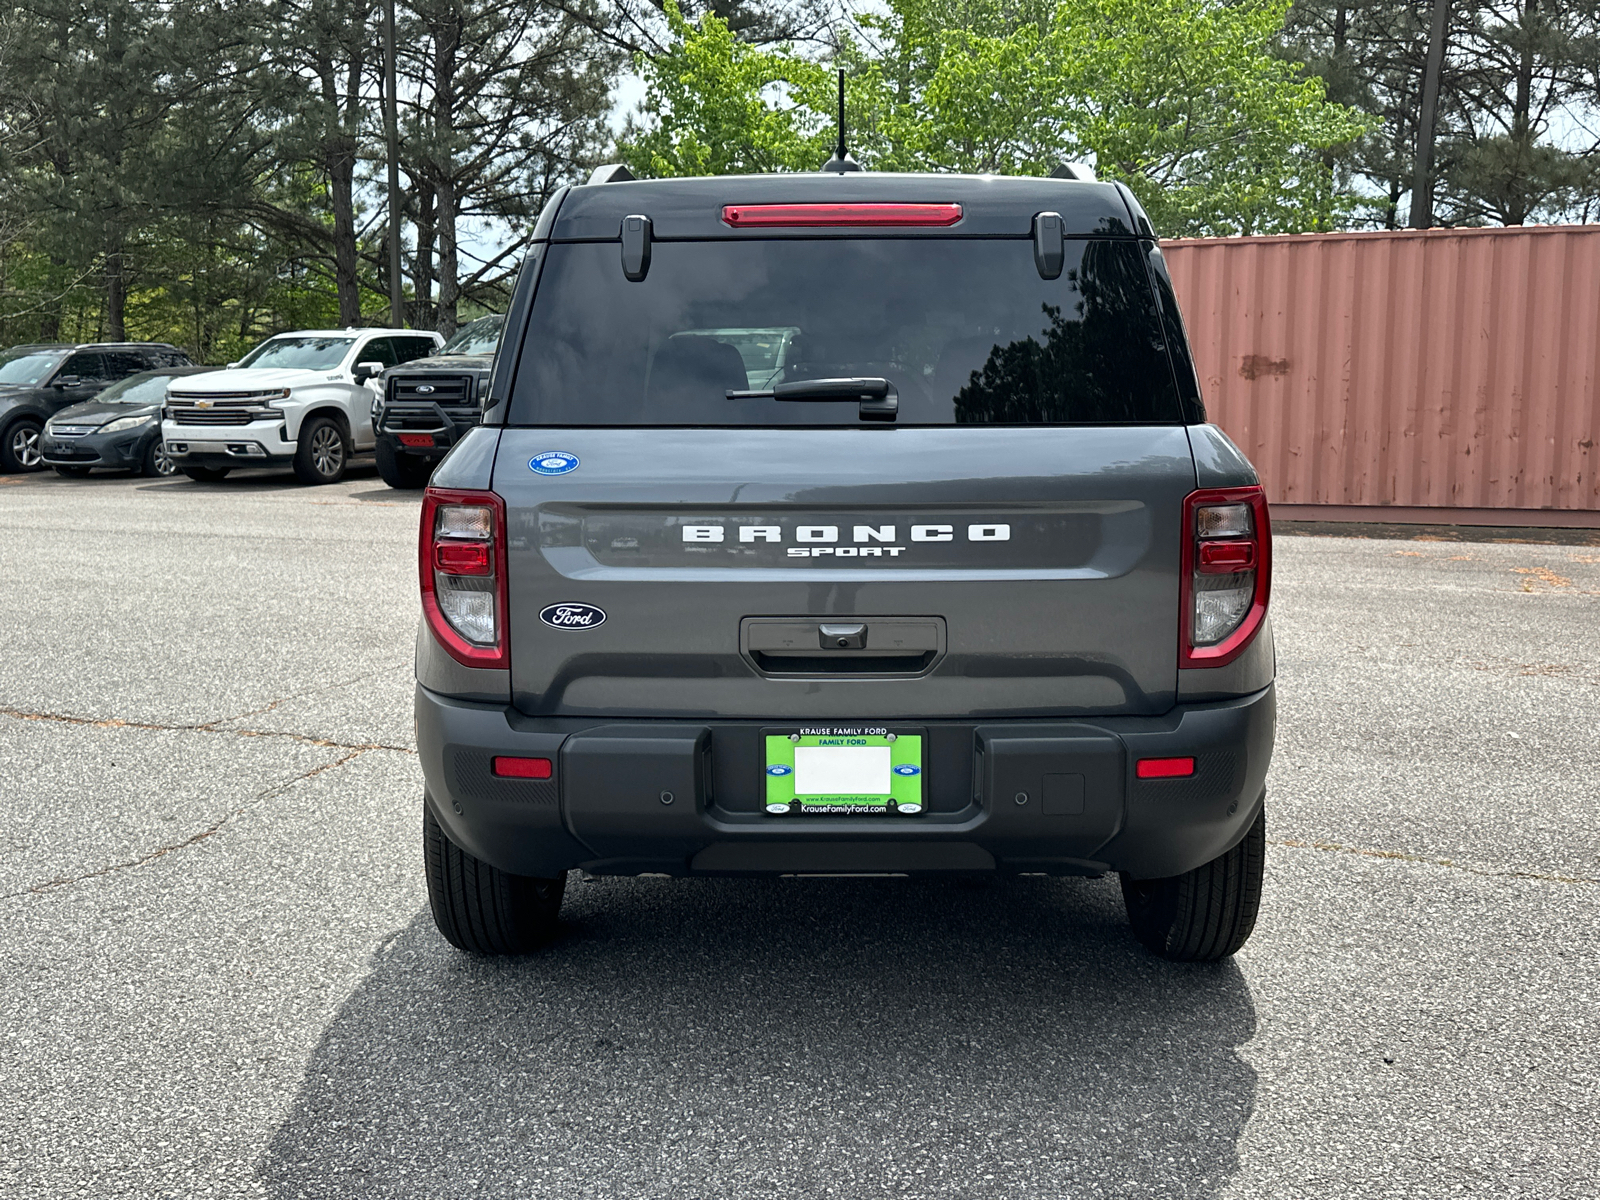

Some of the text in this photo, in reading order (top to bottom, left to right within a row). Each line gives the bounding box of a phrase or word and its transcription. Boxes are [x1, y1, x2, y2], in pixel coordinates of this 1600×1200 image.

[682, 524, 1011, 543] BRONCO
[787, 546, 906, 557] SPORT
[552, 607, 593, 625] Ford
[801, 804, 887, 815] KrauseFamilyFord.com
